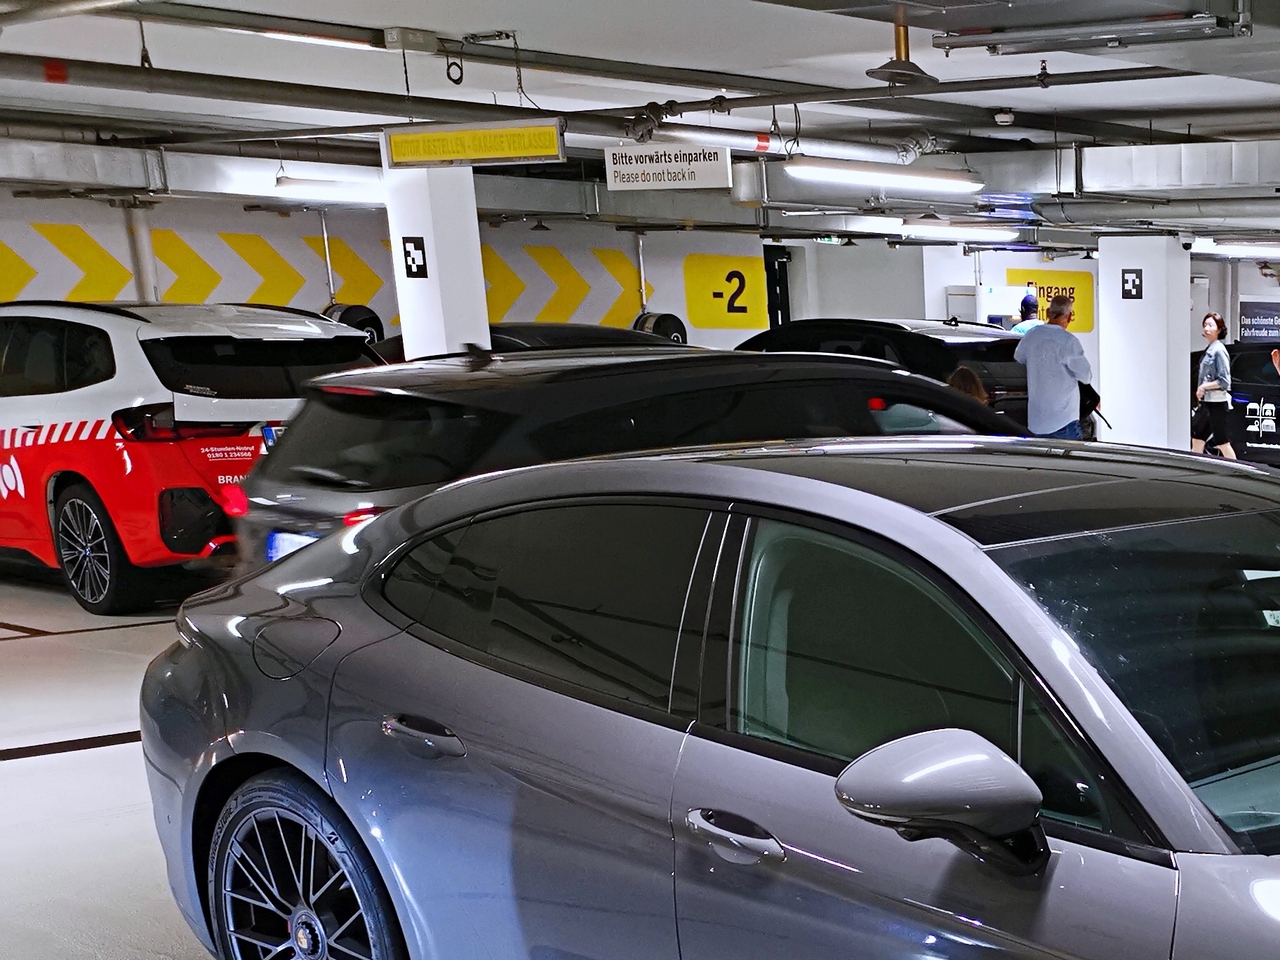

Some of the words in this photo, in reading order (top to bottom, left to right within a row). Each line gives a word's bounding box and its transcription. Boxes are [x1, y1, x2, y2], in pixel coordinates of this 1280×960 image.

[612, 152, 633, 166] Bitte
[634, 150, 672, 164] vorwärts
[674, 149, 719, 166] einparken
[613, 170, 640, 183] Please
[640, 169, 651, 183] do
[652, 169, 666, 182] not
[666, 168, 688, 182] back
[688, 168, 696, 181] in
[712, 270, 749, 313] -2
[1241, 316, 1251, 325] Das
[1252, 315, 1273, 325] schönste
[1241, 327, 1268, 337] Fahrfreude
[1268, 329, 1279, 337] zum
[217, 475, 250, 484] BRAN
